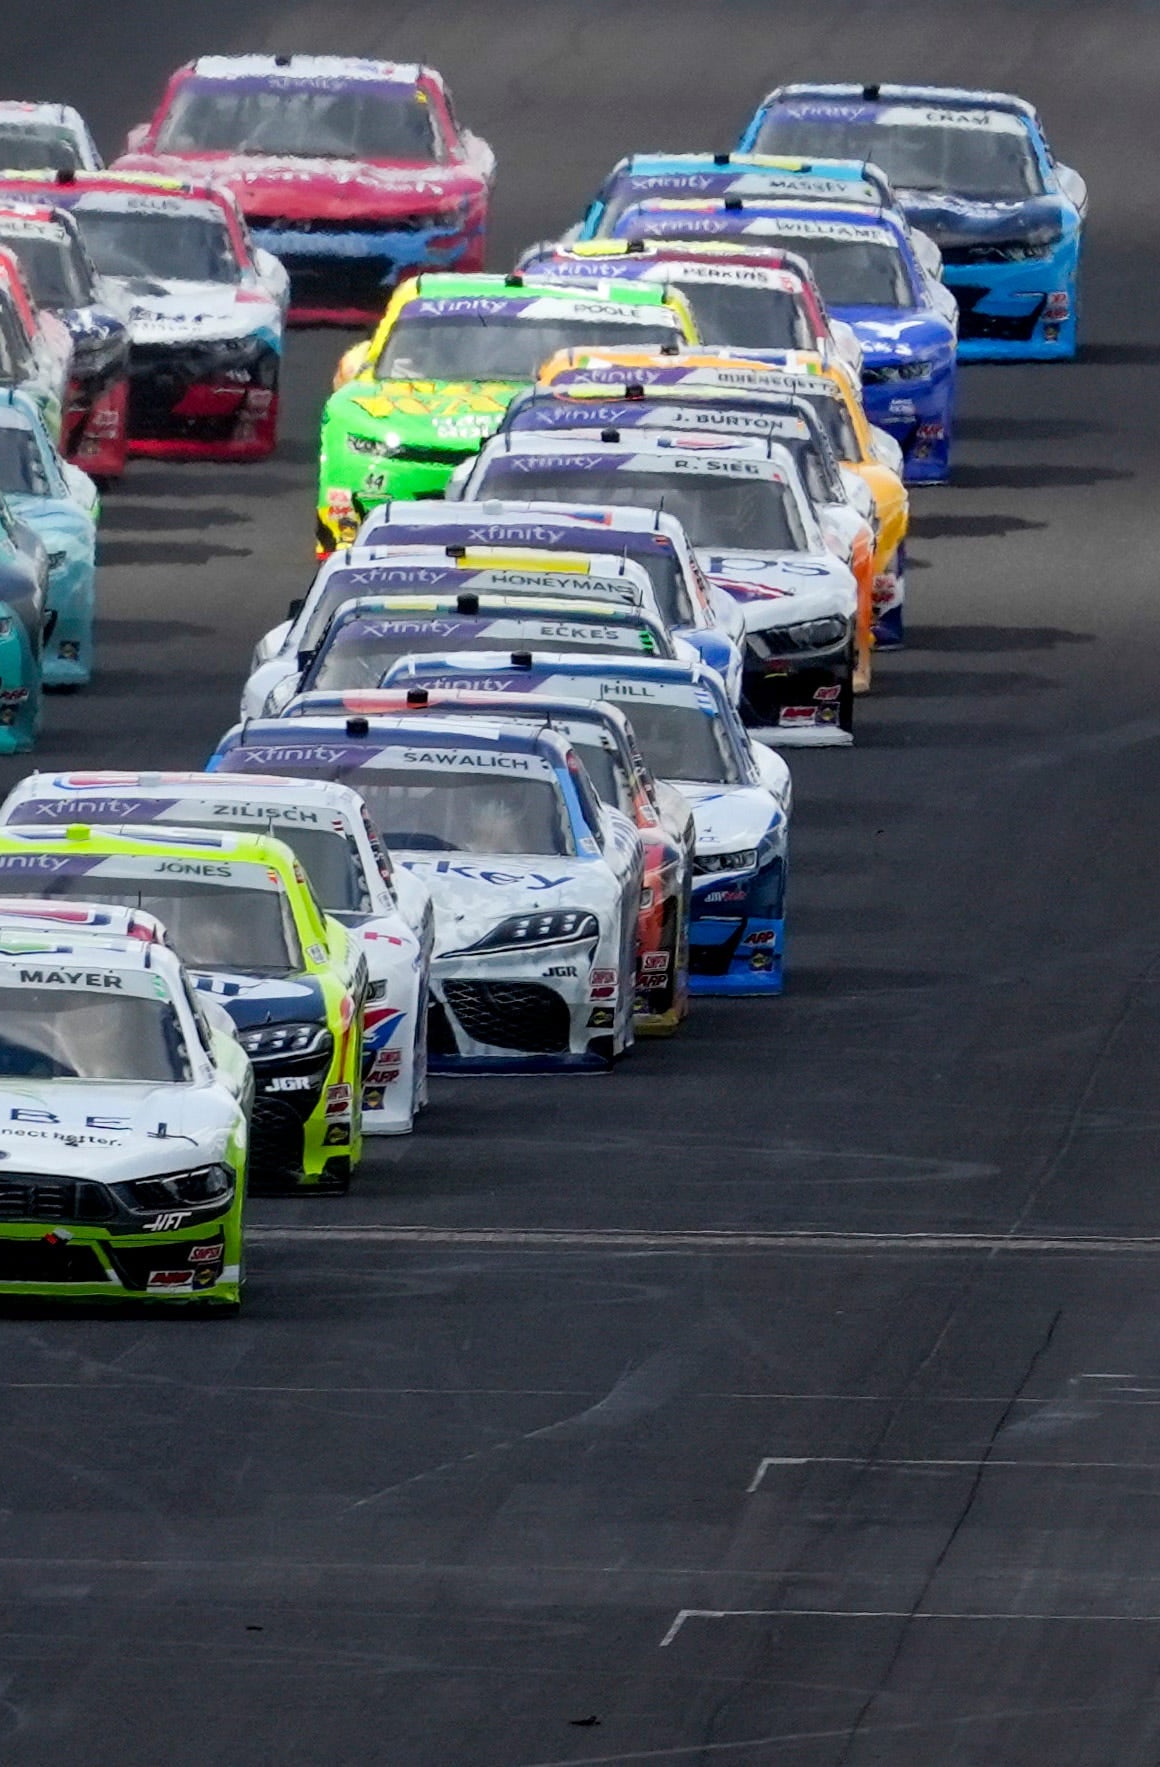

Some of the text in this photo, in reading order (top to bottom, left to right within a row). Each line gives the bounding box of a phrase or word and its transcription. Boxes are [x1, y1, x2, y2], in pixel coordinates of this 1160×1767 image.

[786, 105, 865, 120] xfinity
[632, 175, 715, 189] xfinity
[642, 219, 728, 235] xfinity
[542, 261, 628, 276] xfinity
[419, 299, 509, 314] xfinity
[574, 368, 662, 384] xfinity
[535, 406, 628, 424] xfinity
[671, 414, 784, 430] J. BURTON
[510, 456, 603, 472] xfinity
[674, 460, 760, 475] R. SIEG
[467, 527, 566, 544] xfinity
[350, 568, 448, 585] xfinity
[362, 619, 461, 638] xfinity
[541, 625, 620, 641] ECKES
[414, 678, 514, 692] xfinity
[603, 684, 656, 698] HILL
[244, 745, 346, 764] xfinity
[402, 752, 530, 771] SAWALICH
[35, 799, 141, 817] xfinity
[213, 803, 319, 824] ZILISCH
[154, 861, 233, 878] JONES
[19, 969, 124, 990] MAYER
[542, 966, 579, 978] JGR
[264, 1076, 312, 1092] JGR
[142, 1211, 192, 1232] HFT
